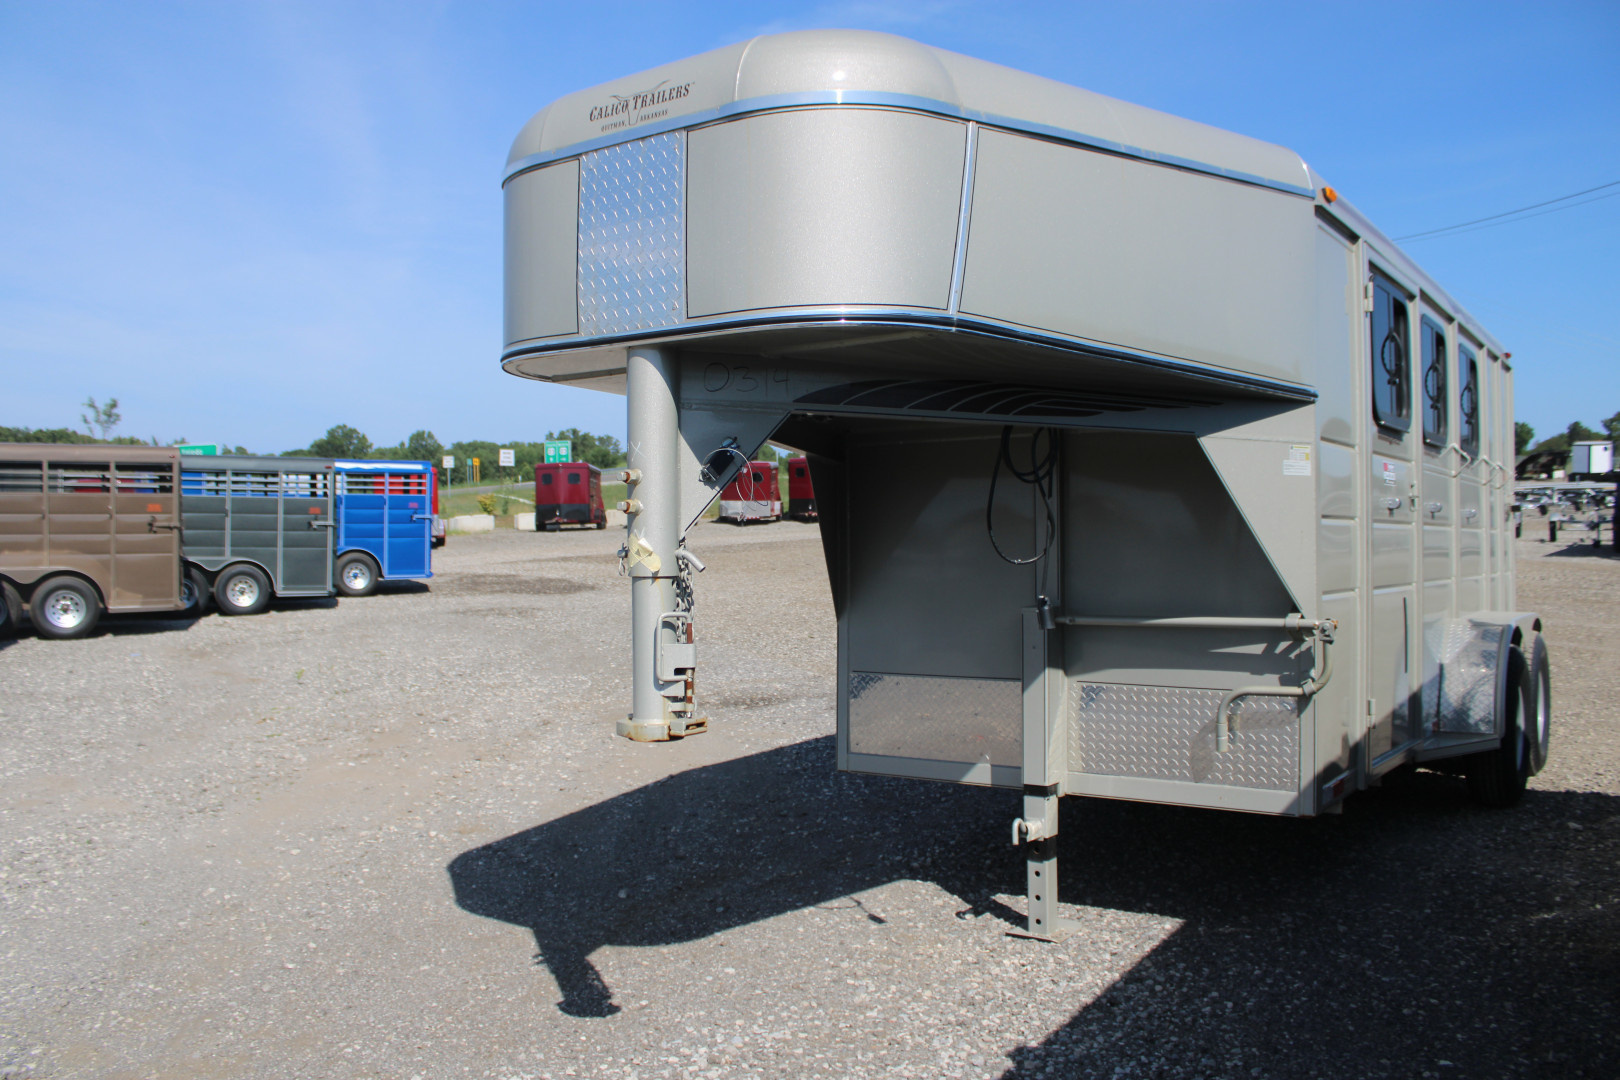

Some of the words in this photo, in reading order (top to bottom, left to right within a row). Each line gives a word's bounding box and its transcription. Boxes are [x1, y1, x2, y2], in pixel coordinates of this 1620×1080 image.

[589, 101, 629, 122] CALICO
[632, 83, 690, 110] TRAILERS
[640, 109, 668, 122] ARKANSAS
